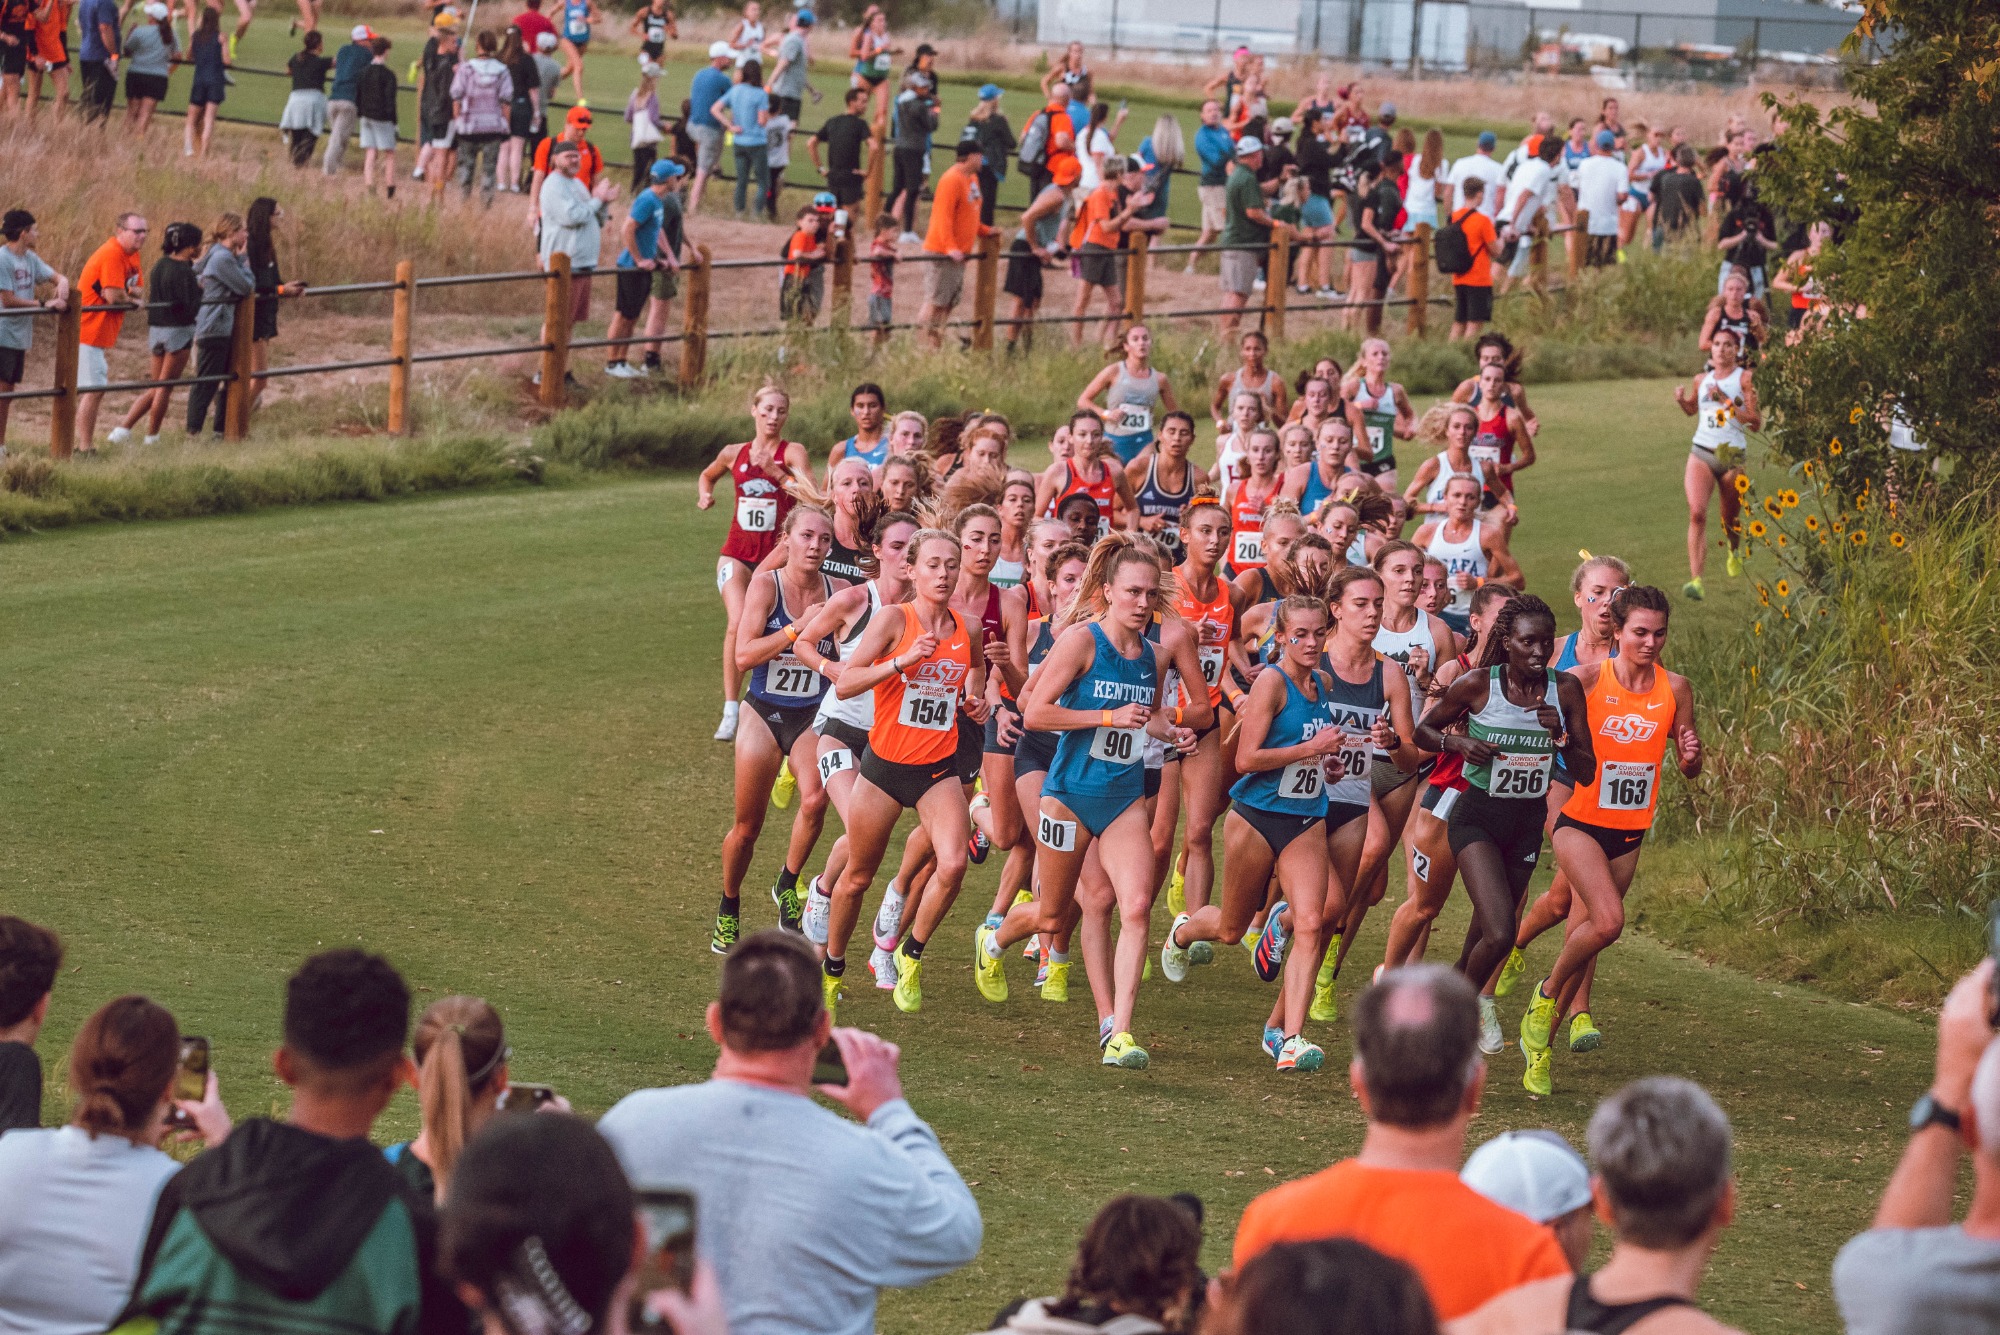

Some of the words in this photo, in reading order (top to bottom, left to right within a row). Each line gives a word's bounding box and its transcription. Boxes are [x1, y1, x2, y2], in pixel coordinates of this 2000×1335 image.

[1121, 414, 1146, 428] 233
[747, 510, 765, 528] 16
[775, 668, 813, 693] 277
[1093, 680, 1156, 705] KENTUCK
[909, 698, 949, 725] 154
[1486, 733, 1517, 746] UTAH
[1519, 735, 1553, 748] VALLE
[1599, 713, 1658, 744] OSU
[1103, 730, 1133, 760] 90
[821, 751, 843, 779] 84
[1290, 768, 1319, 794] 26
[1495, 768, 1544, 794] 256
[1608, 779, 1648, 805] 163
[1041, 817, 1065, 848] 90
